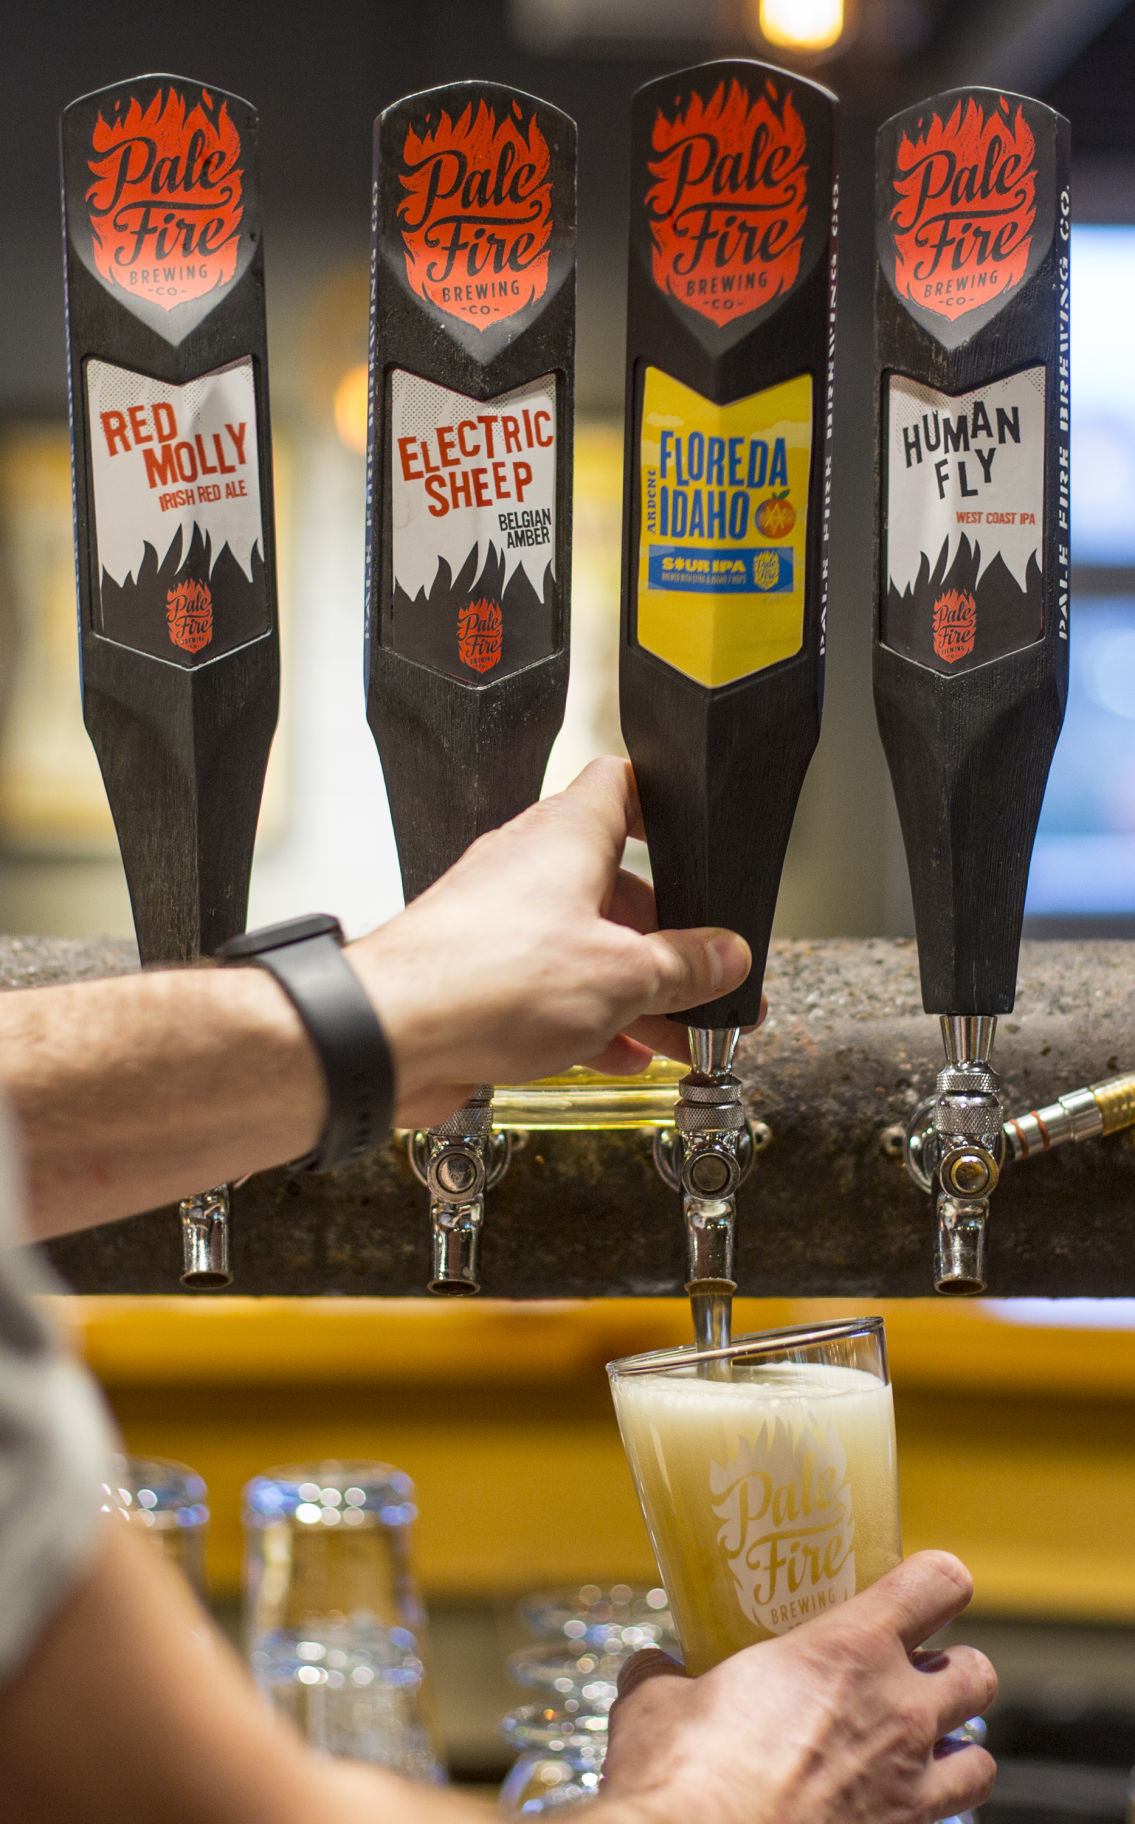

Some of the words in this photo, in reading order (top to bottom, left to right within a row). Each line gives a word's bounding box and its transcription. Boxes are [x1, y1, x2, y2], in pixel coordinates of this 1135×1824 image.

[86, 128, 237, 217] Pale
[398, 140, 542, 233] Pale
[647, 122, 799, 223] Pale
[892, 134, 1029, 236] Pale
[113, 186, 238, 267] Fire
[424, 200, 547, 283] Fire
[673, 184, 803, 276] Fire
[913, 188, 1032, 281] Fire
[129, 263, 208, 286] BREWING
[442, 279, 520, 303] BREWING
[686, 271, 768, 297] BREWING
[924, 269, 998, 298] BREWING
[1058, 256, 1070, 433] BREWING
[100, 402, 178, 457] RED
[142, 422, 247, 489] MOLLY
[397, 409, 554, 482] ELECTRIC
[902, 400, 1021, 469] HUMAN
[660, 430, 788, 490] FLOREDA
[934, 447, 997, 500] FLY
[1058, 445, 1069, 530] FIRE
[159, 488, 195, 512] IRISH
[197, 483, 221, 504] RED
[225, 480, 248, 499] ALE
[424, 461, 533, 518] SHEEP
[659, 485, 750, 541] IDAHO
[498, 508, 552, 532] BELGIAN
[506, 526, 551, 550] AMBER
[956, 511, 984, 525] WEST
[986, 512, 1017, 525] COAST
[1019, 512, 1036, 526] IPA
[662, 556, 710, 572] SOUR
[712, 560, 747, 573] IPA
[1058, 543, 1069, 641] PALE
[166, 591, 210, 623] Pale
[175, 609, 212, 639] Fire
[457, 610, 501, 641] Pale
[932, 600, 976, 632] Pale
[938, 619, 976, 649] Fire
[465, 629, 502, 658] Fire
[712, 1450, 841, 1559] Pale
[745, 1501, 849, 1606] Fire
[770, 1587, 836, 1624] BREWING
